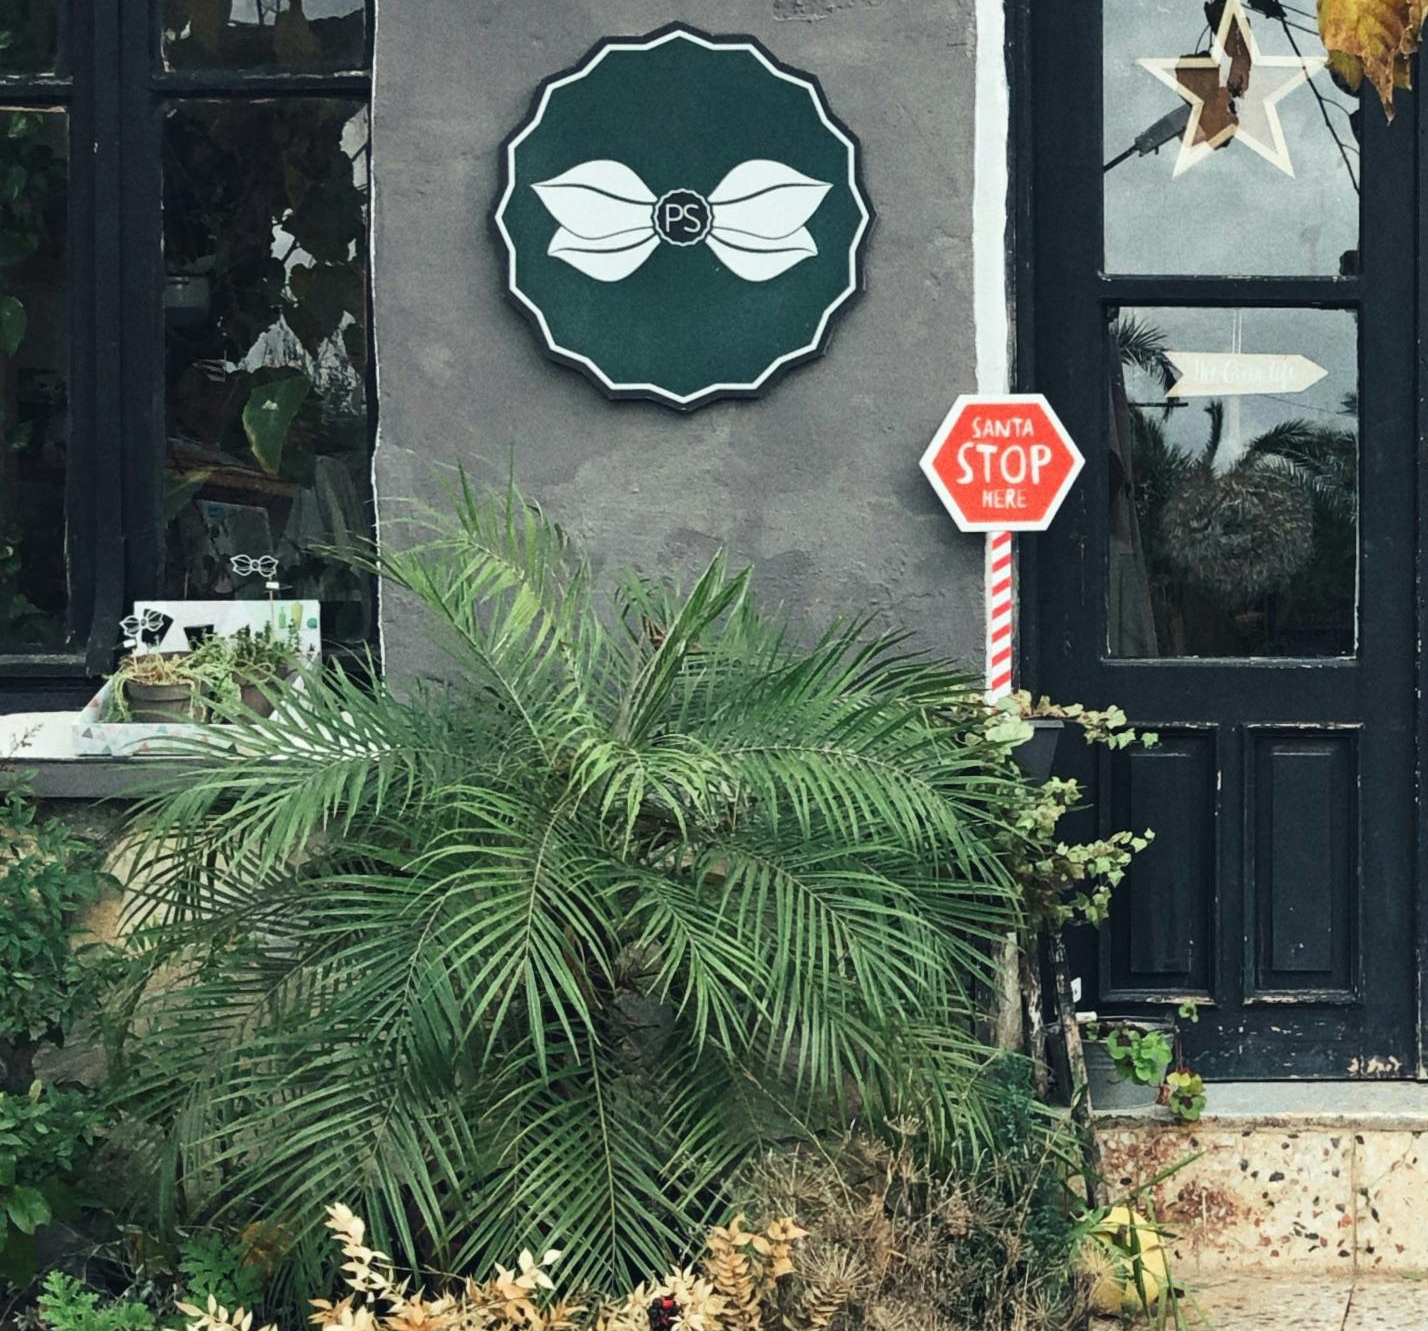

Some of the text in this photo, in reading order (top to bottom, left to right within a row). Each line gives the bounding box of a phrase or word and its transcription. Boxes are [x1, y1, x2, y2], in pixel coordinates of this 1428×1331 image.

[665, 203, 701, 233] PS
[971, 416, 1035, 439] SANTA
[955, 441, 1053, 486] STOP
[981, 488, 1028, 509] HERE
